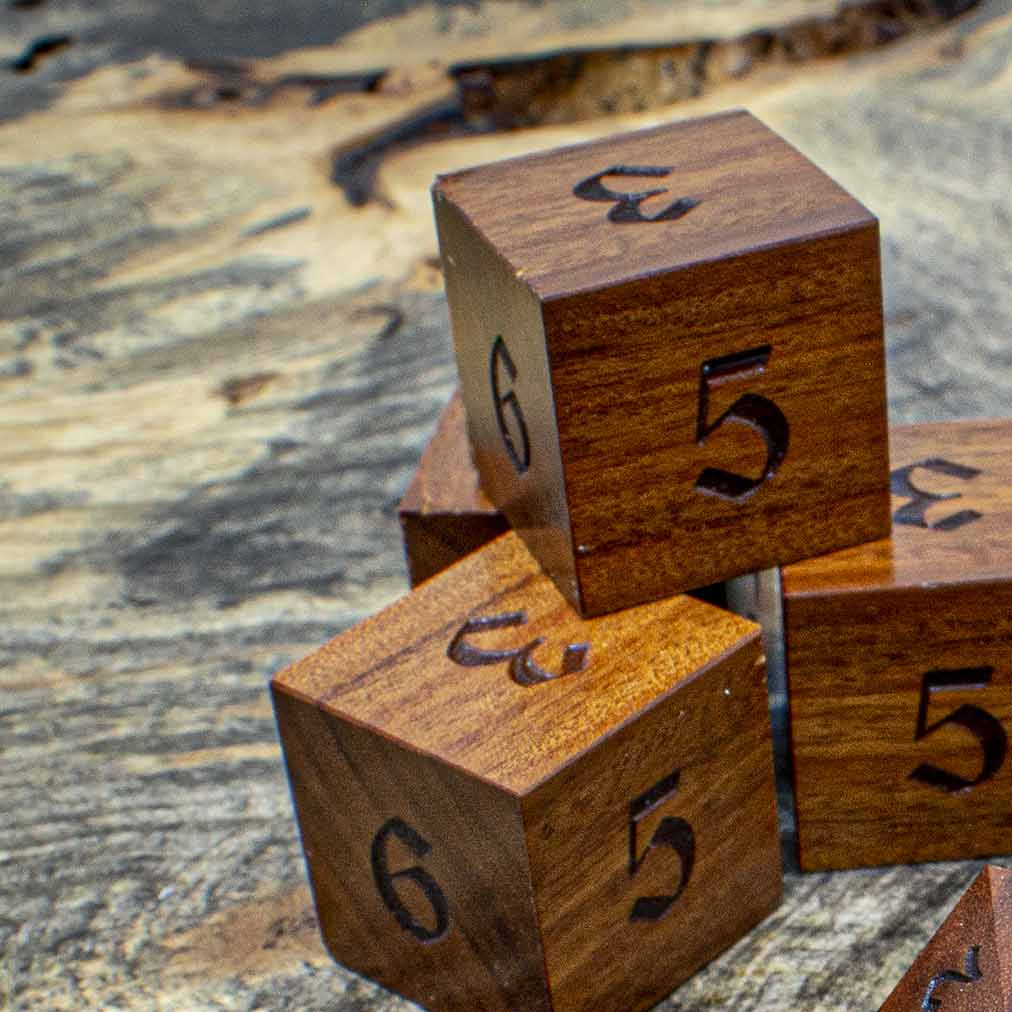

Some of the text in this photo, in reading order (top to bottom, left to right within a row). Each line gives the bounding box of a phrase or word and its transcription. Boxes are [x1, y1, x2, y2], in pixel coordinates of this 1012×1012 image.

[572, 165, 703, 223] 3
[489, 334, 531, 474] 6
[695, 344, 790, 502] 5
[447, 612, 590, 686] 3
[909, 665, 1007, 794] 5
[371, 817, 451, 943] 6
[627, 769, 695, 923] 5
